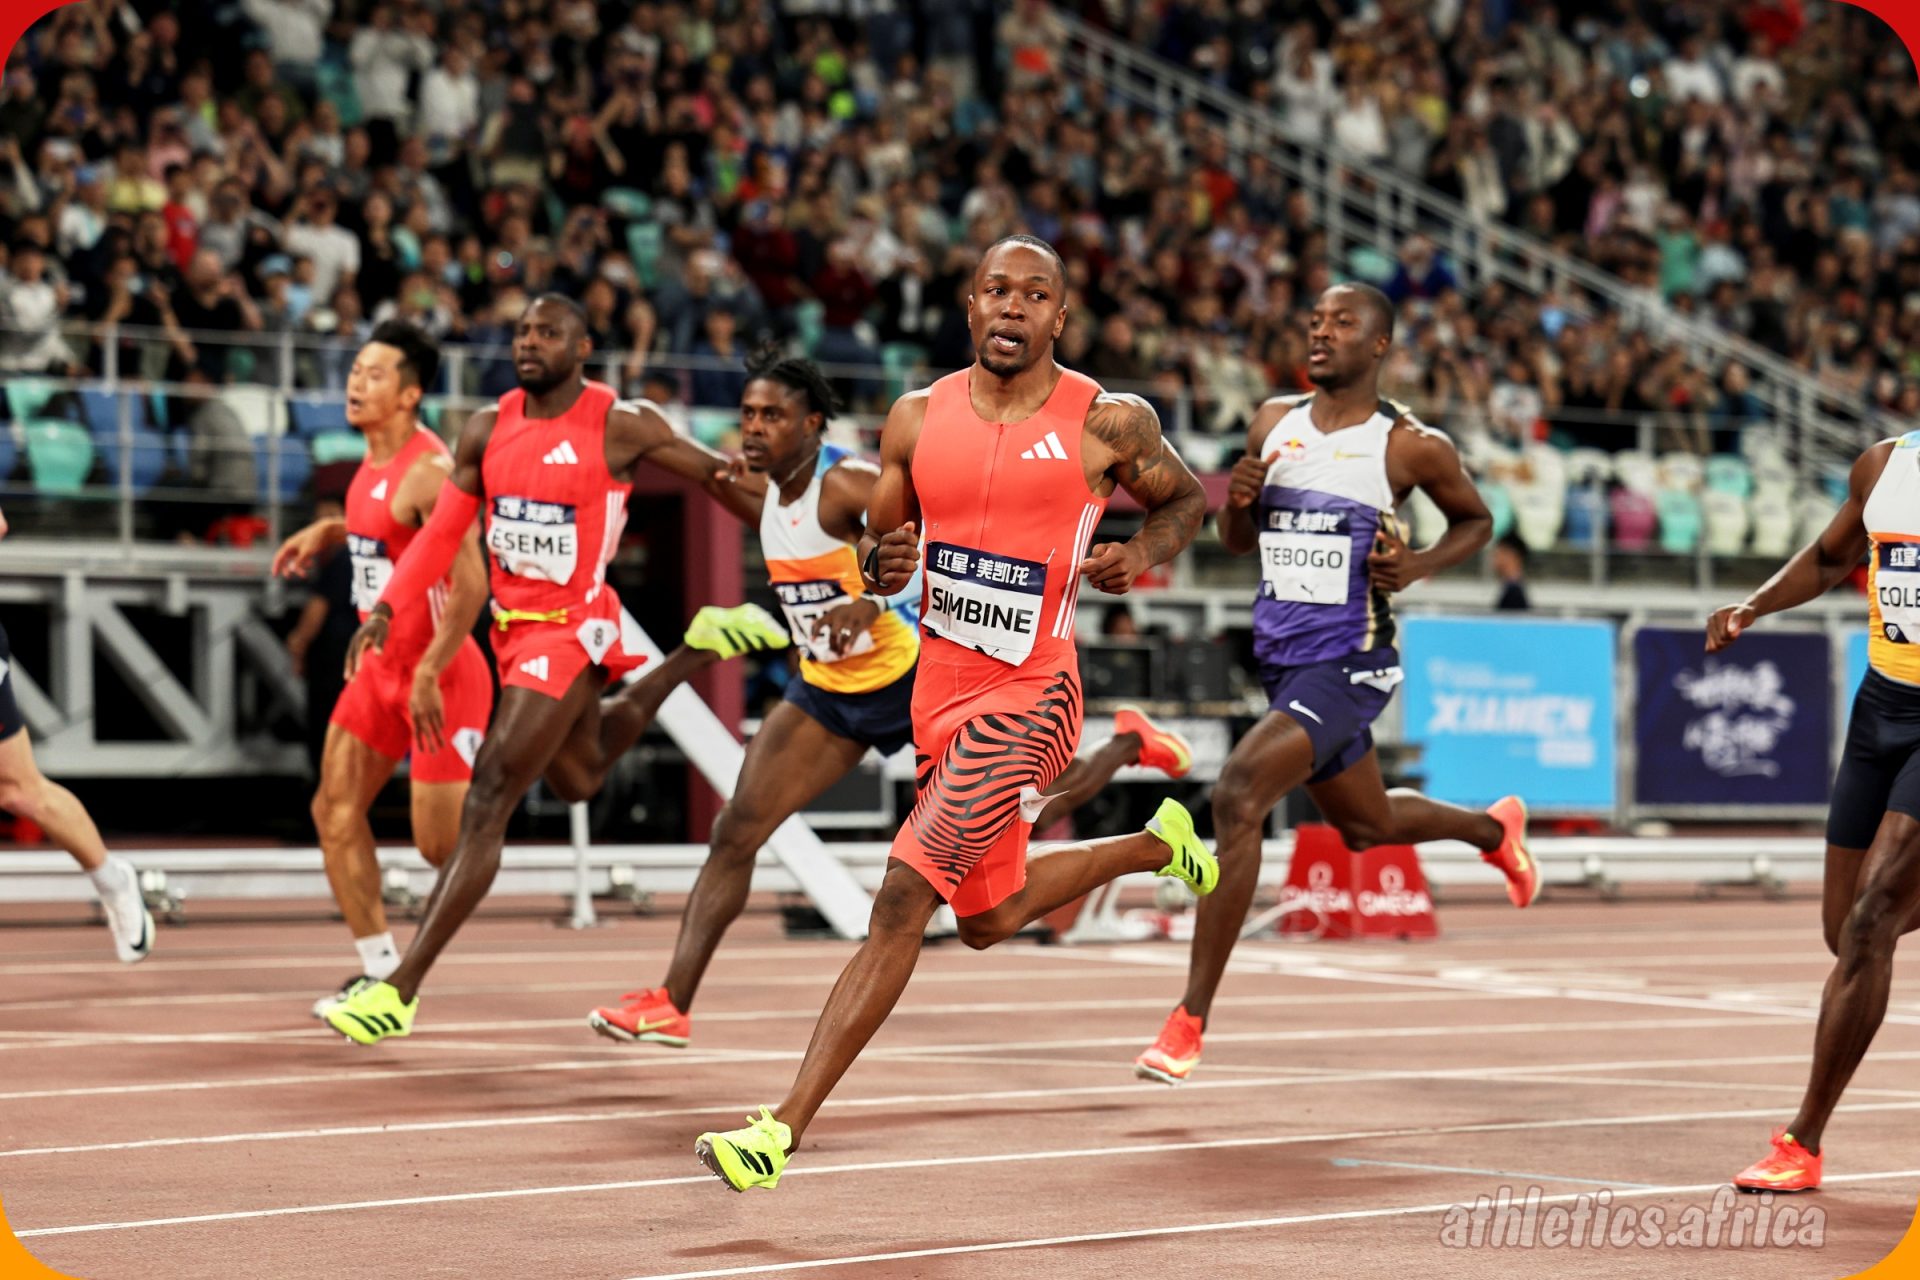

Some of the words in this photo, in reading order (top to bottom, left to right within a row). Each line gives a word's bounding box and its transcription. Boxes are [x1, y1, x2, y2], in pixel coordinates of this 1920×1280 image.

[492, 527, 572, 555] ESEME
[936, 548, 1030, 586] 红星·美凯龙
[1265, 547, 1343, 569] TEBOGO
[932, 587, 1034, 635] SIMBINE
[594, 626, 604, 647] 8
